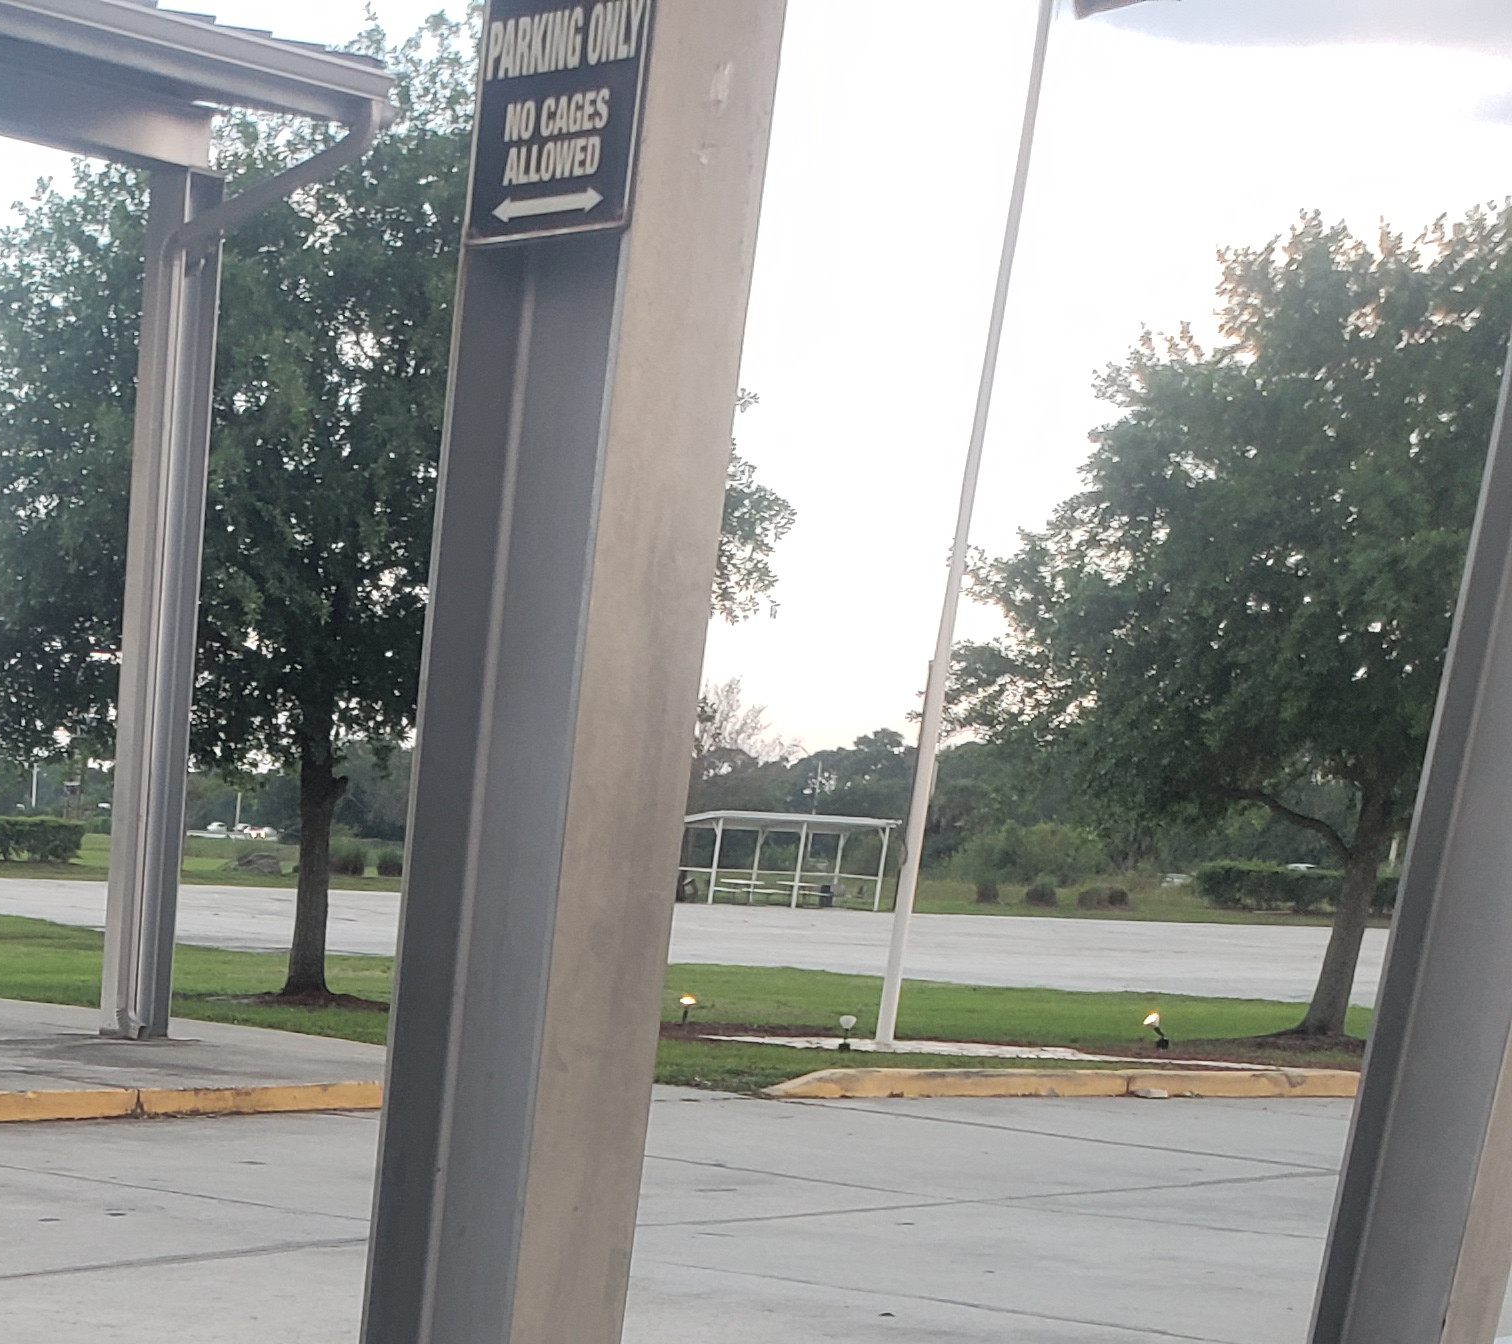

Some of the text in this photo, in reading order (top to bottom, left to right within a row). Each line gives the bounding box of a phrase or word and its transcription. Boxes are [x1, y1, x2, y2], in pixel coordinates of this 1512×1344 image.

[486, 0, 643, 81] PARKING ONLY
[504, 87, 610, 142] NO CAGES
[502, 135, 601, 186] ALLOWED
